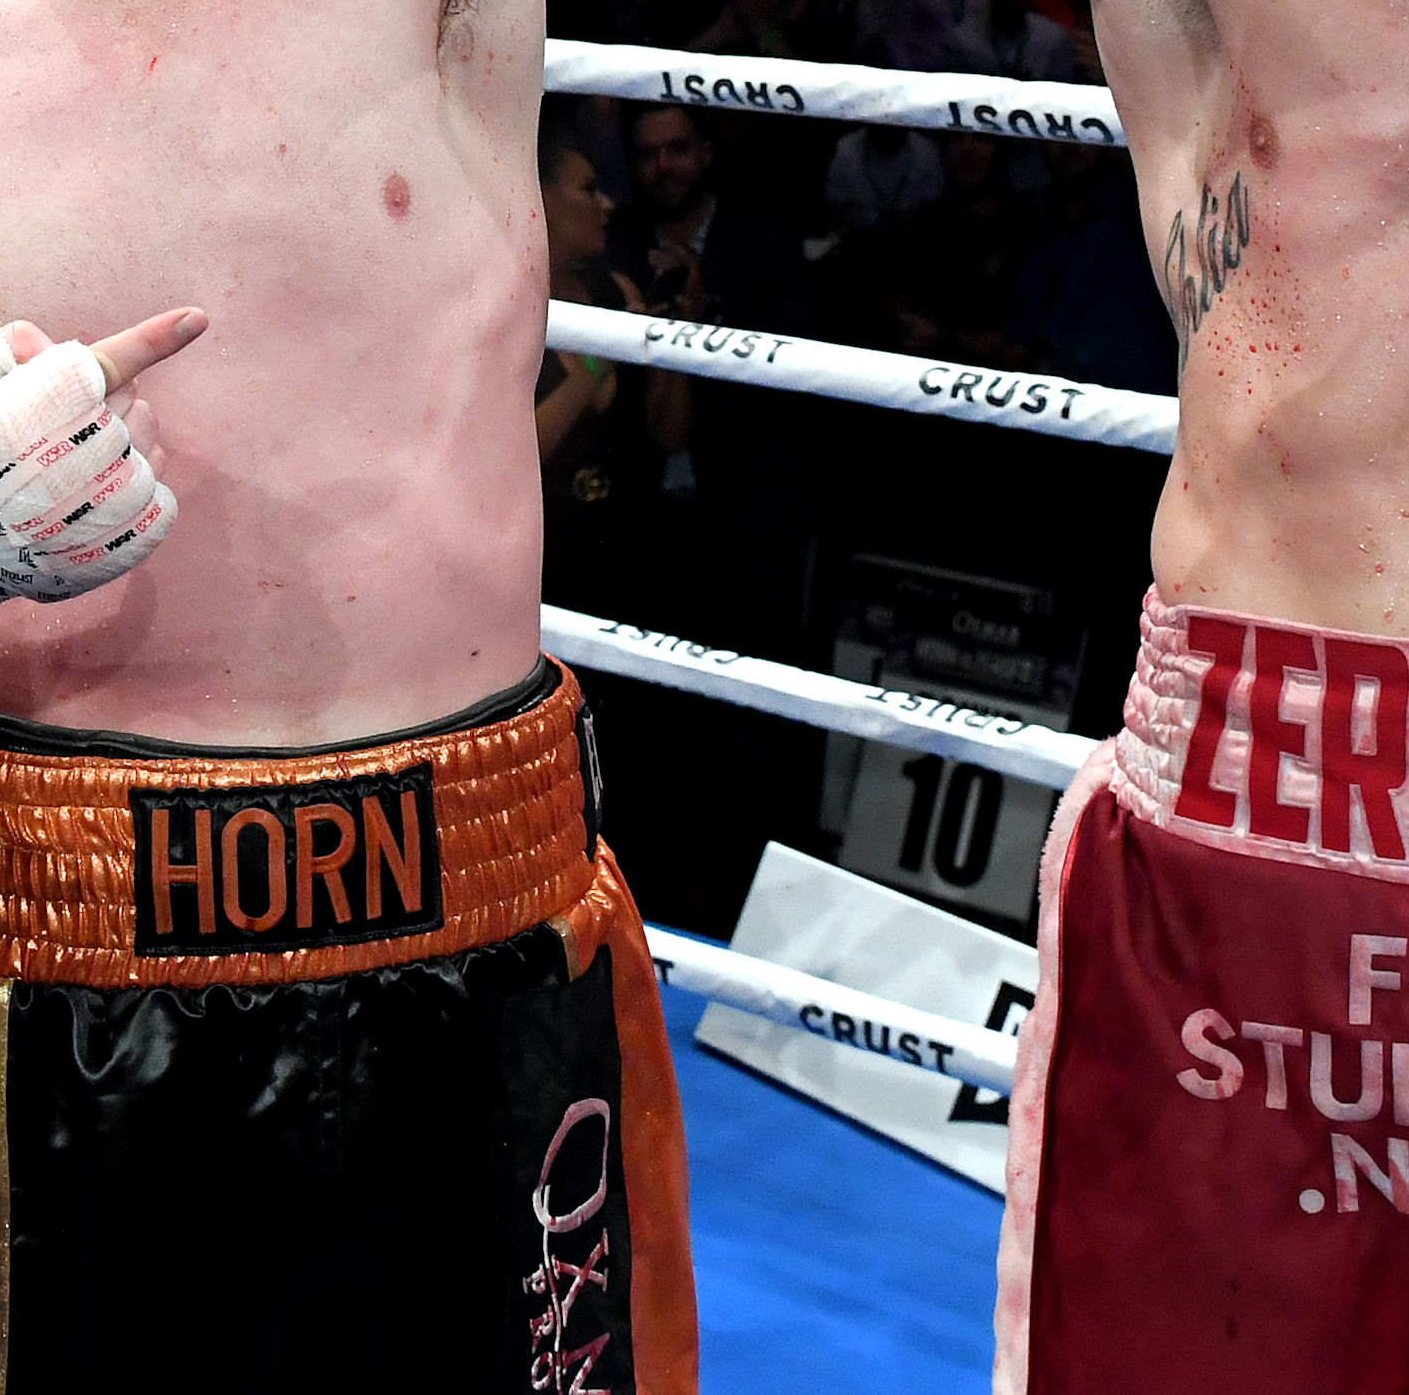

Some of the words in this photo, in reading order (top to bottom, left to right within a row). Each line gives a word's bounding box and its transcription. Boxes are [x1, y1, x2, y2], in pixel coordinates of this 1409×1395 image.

[660, 71, 805, 113] CRUST
[947, 101, 1114, 145] CRUST
[644, 319, 794, 366] CRUST
[917, 366, 1086, 420] CRUST
[69, 422, 101, 446] WAR
[62, 501, 94, 525] WAR
[105, 529, 137, 552] WAR
[0, 568, 34, 585] EVERLAST
[899, 753, 1005, 890] 10
[150, 791, 423, 934] HORN
[799, 1003, 955, 1074] CRUST
